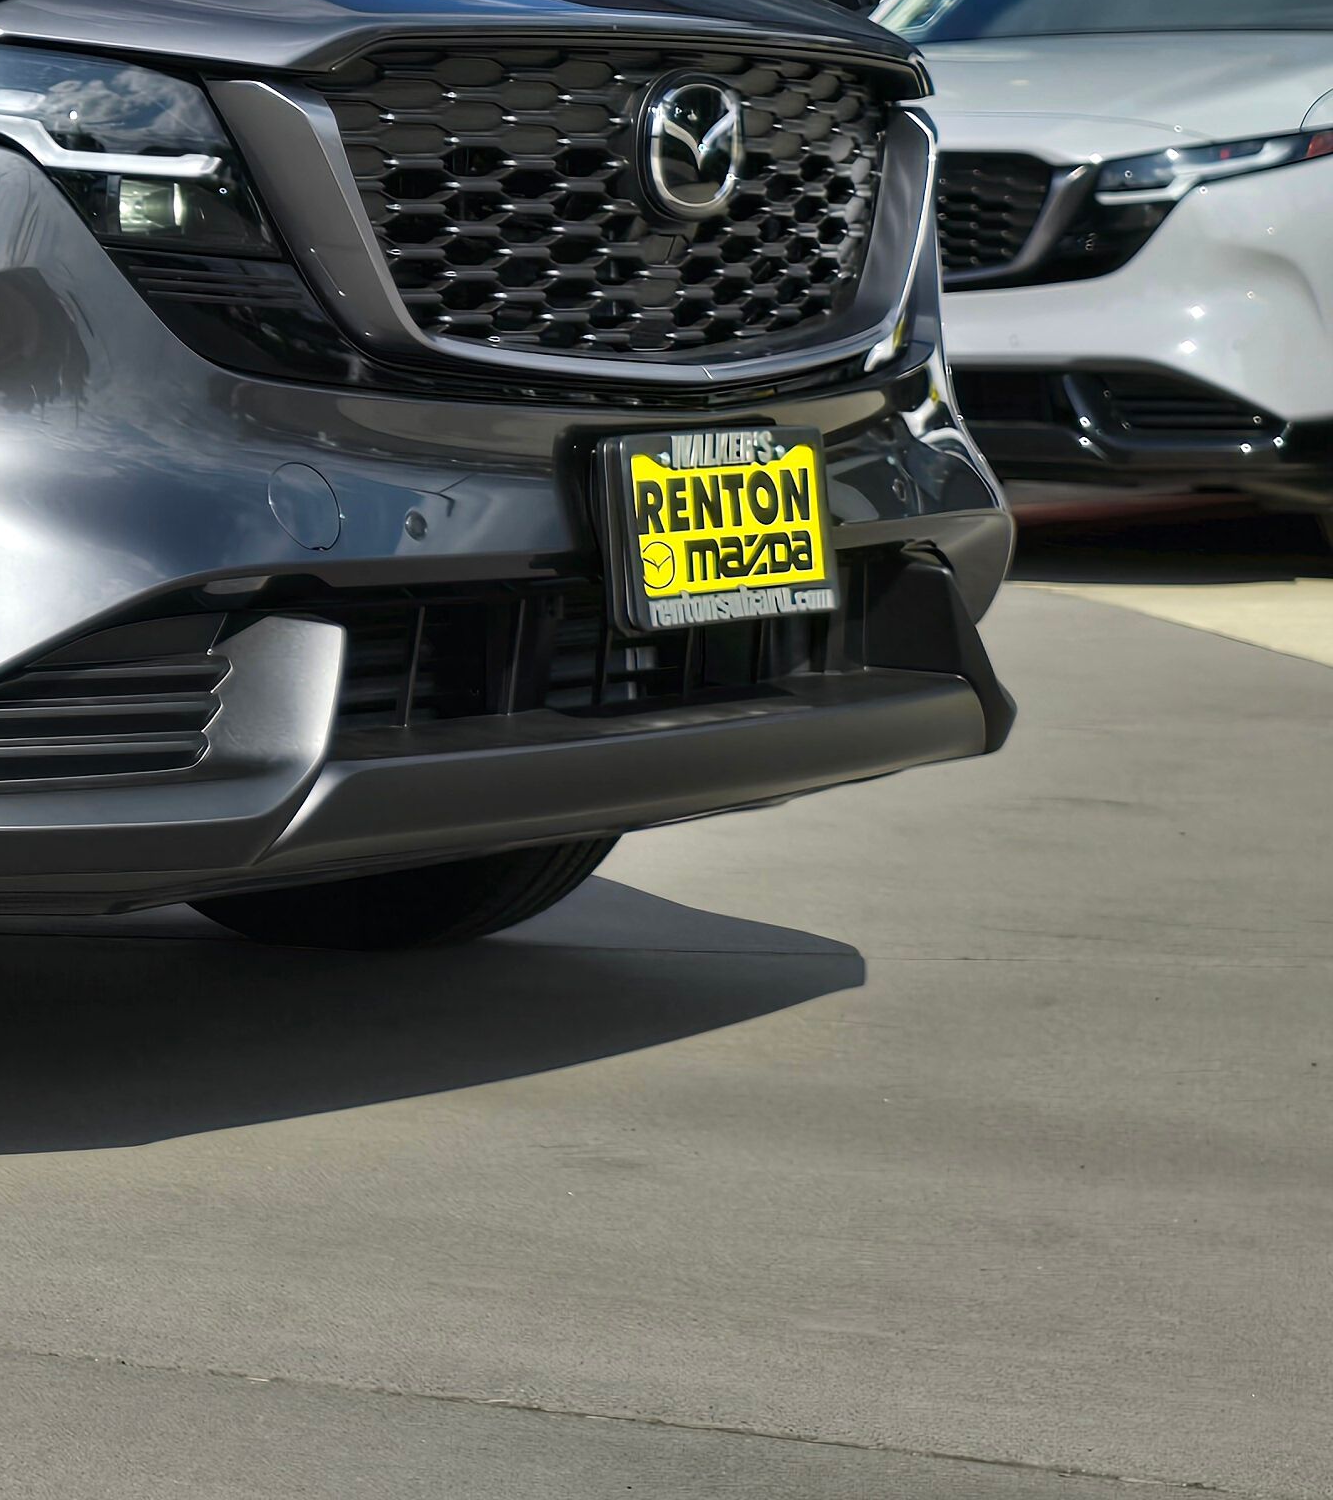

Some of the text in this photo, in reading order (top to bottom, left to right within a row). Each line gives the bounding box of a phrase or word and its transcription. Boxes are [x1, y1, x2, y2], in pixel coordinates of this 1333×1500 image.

[671, 430, 773, 470] WALKER'S
[637, 467, 811, 536] RENTON
[683, 530, 813, 583] mazda
